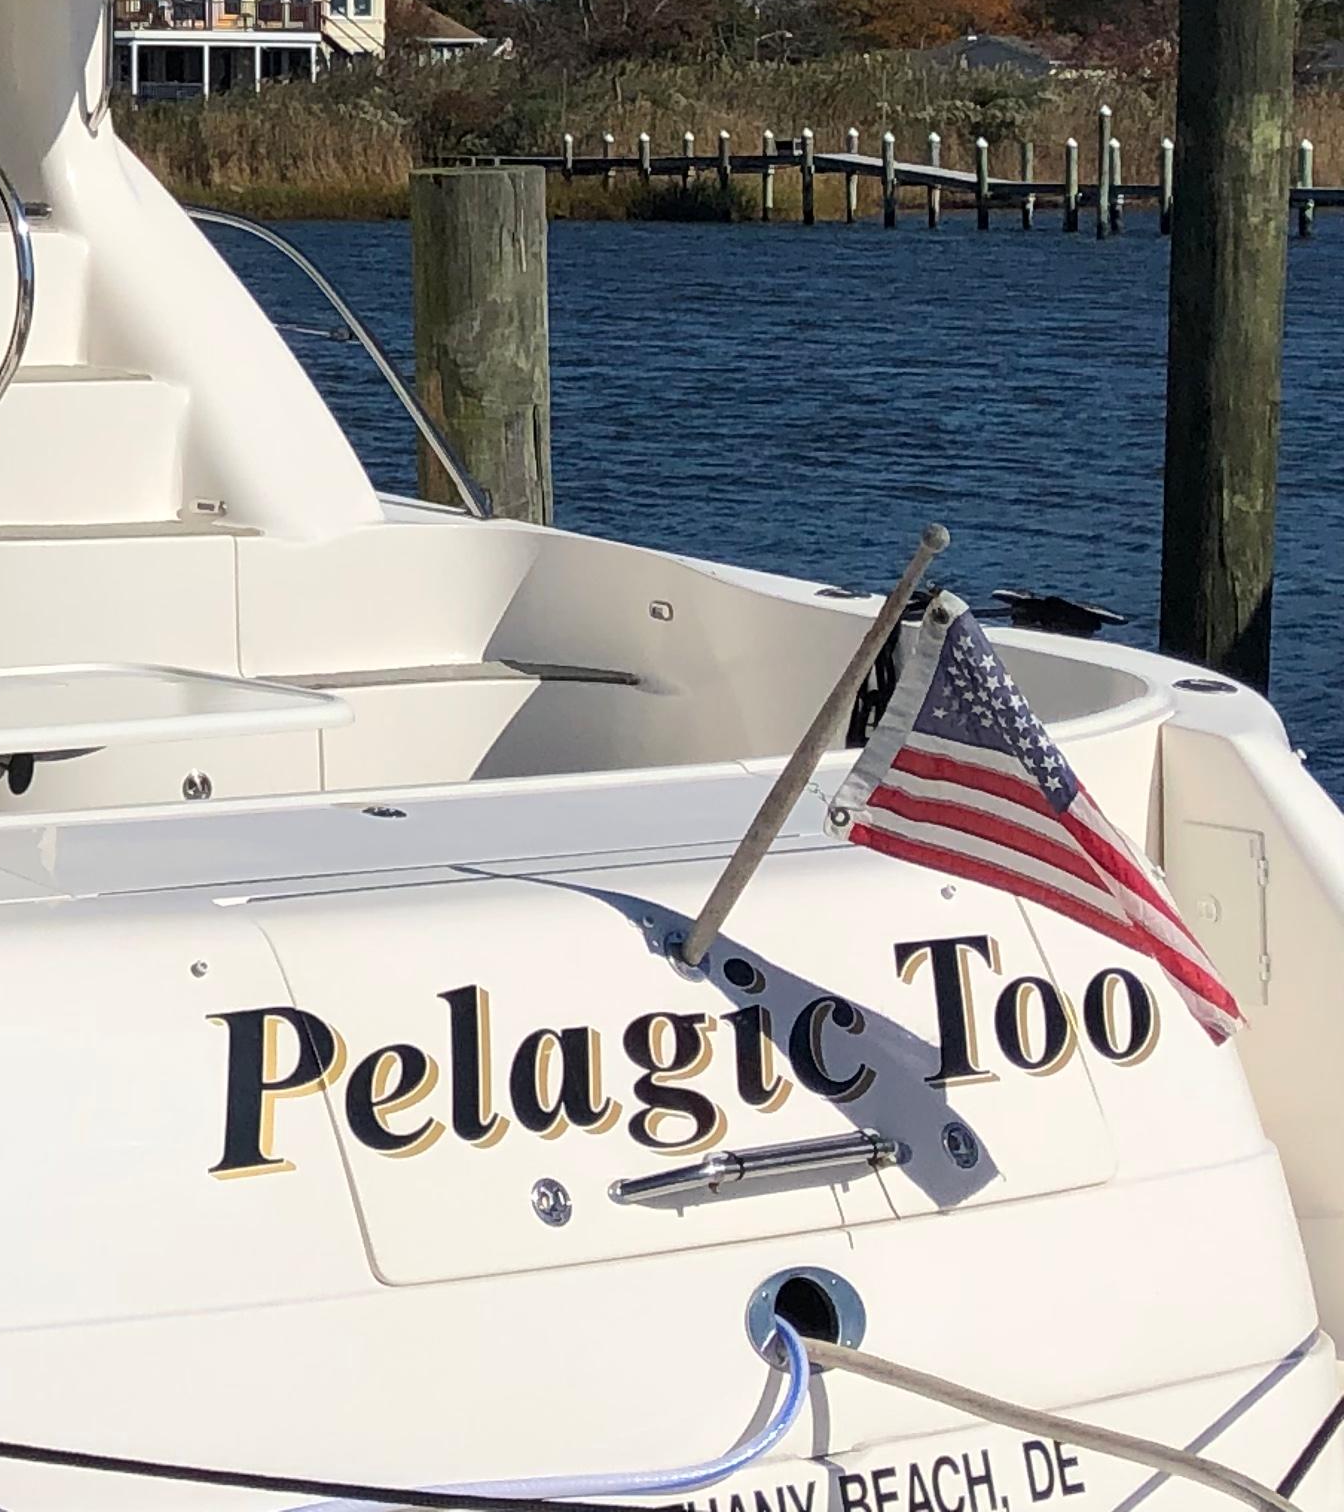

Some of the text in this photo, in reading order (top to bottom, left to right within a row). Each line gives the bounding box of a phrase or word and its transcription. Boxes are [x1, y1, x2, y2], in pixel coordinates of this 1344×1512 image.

[206, 934, 1161, 1181] Pelagic Too
[838, 1448, 1010, 1512] BEACH,
[1022, 1439, 1086, 1502] DE
